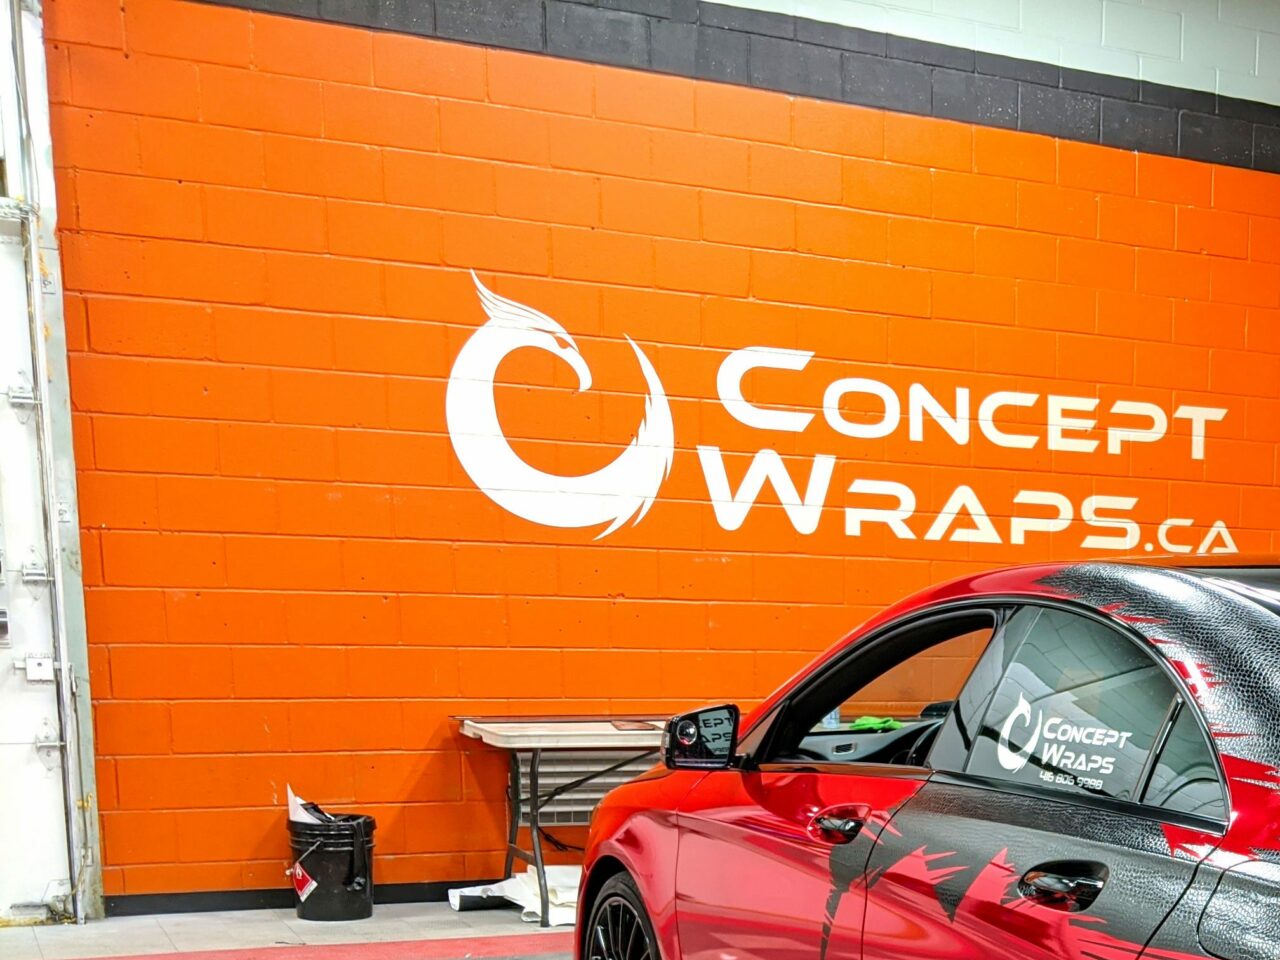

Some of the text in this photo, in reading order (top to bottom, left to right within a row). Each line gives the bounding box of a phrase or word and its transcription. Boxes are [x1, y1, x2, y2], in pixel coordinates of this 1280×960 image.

[716, 346, 1229, 461] CONCEPT
[1043, 718, 1132, 748] CONCEPT
[1042, 743, 1115, 774] WRAPS
